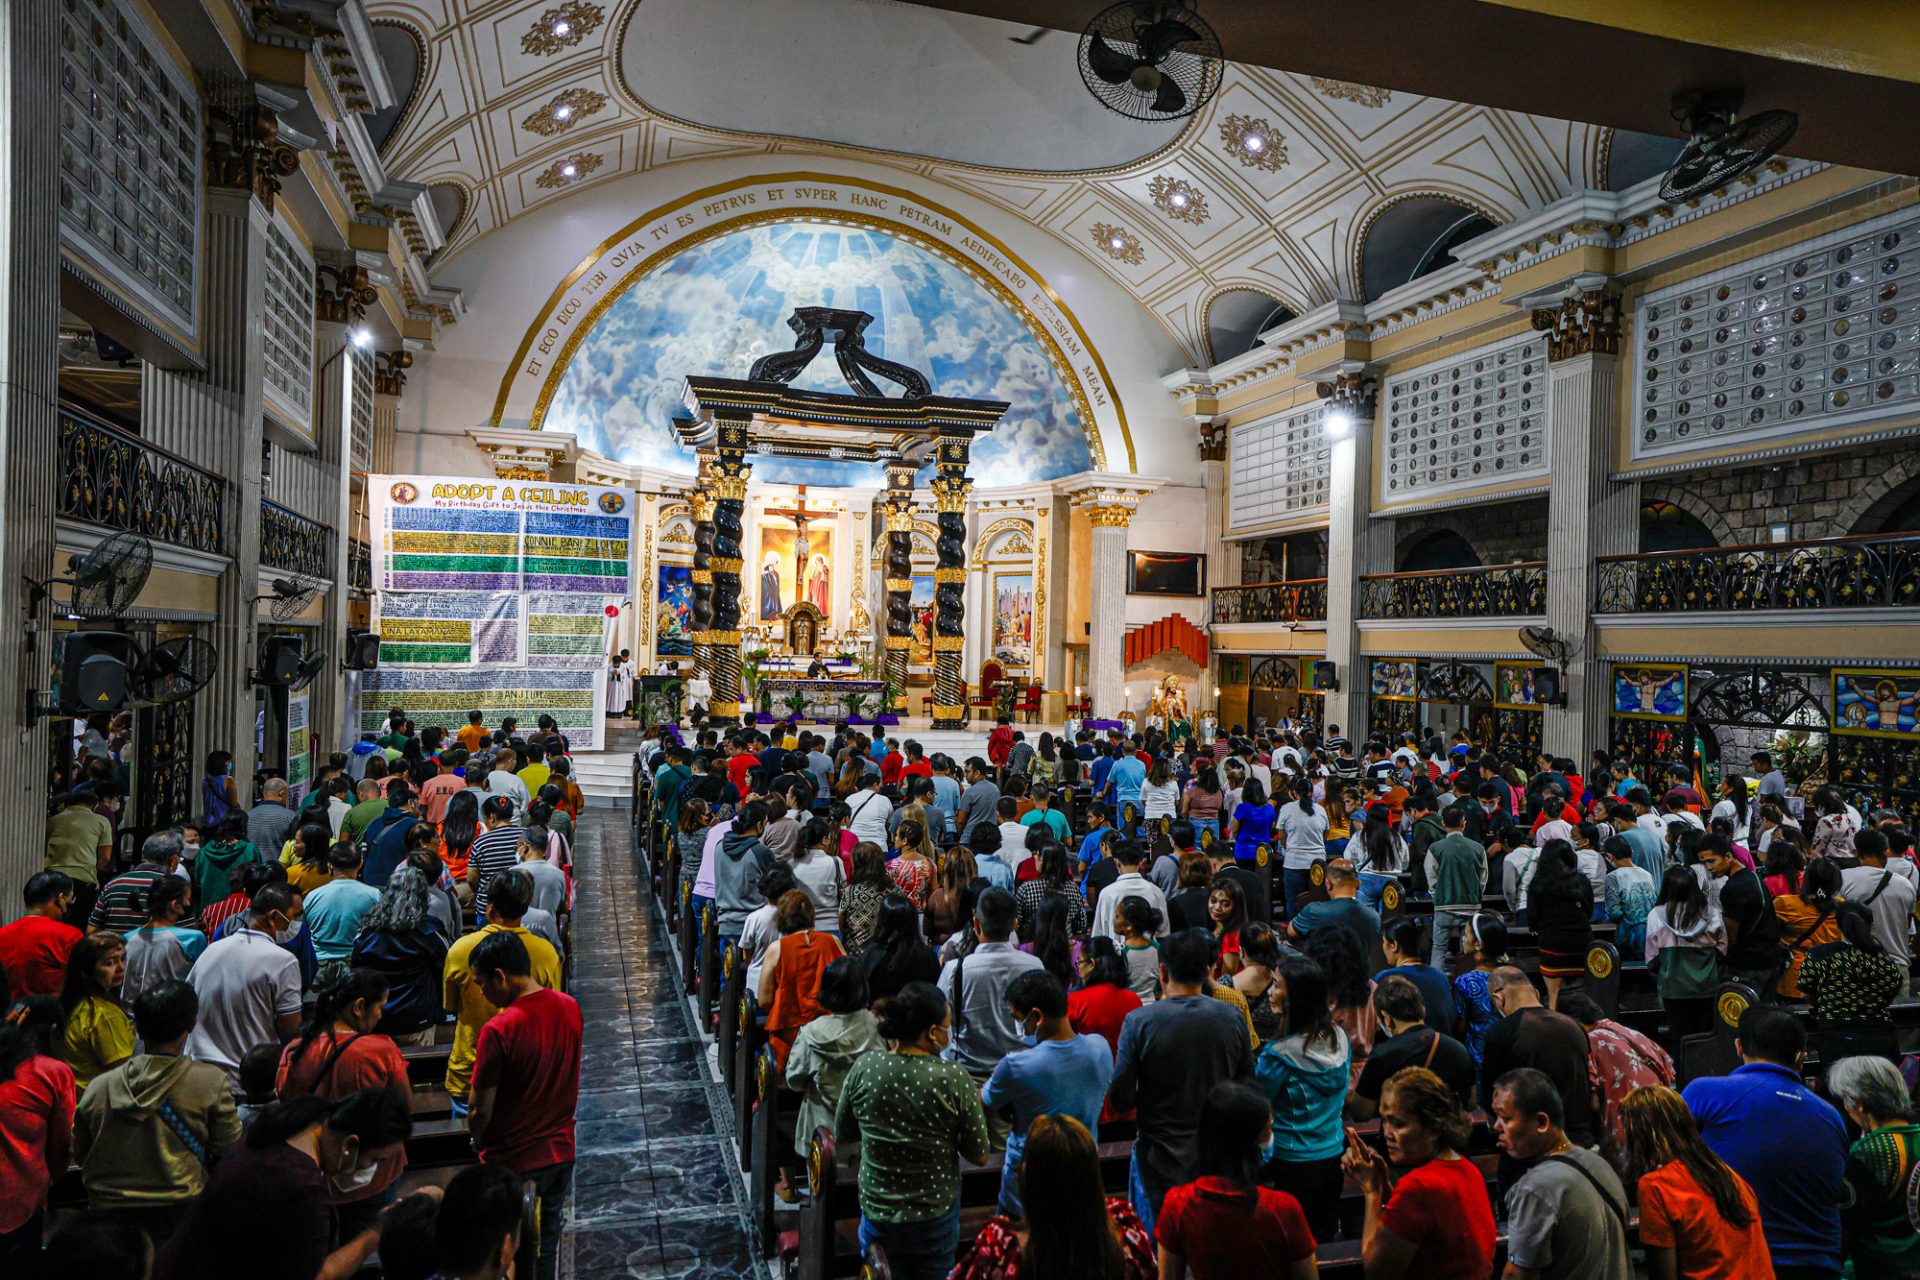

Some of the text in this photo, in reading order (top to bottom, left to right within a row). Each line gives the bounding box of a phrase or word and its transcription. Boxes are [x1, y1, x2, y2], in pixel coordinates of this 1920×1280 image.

[526, 187, 1107, 407] ET EGO DICO TIBI QVIA TV ES PETRVS ET SVPER HANC PETRAM AEDIFICABO ECCLESIAM MEAM
[432, 483, 589, 506] ADOPT A CEILING
[434, 499, 587, 514] My Birthday Gift to Jesus this Christmas
